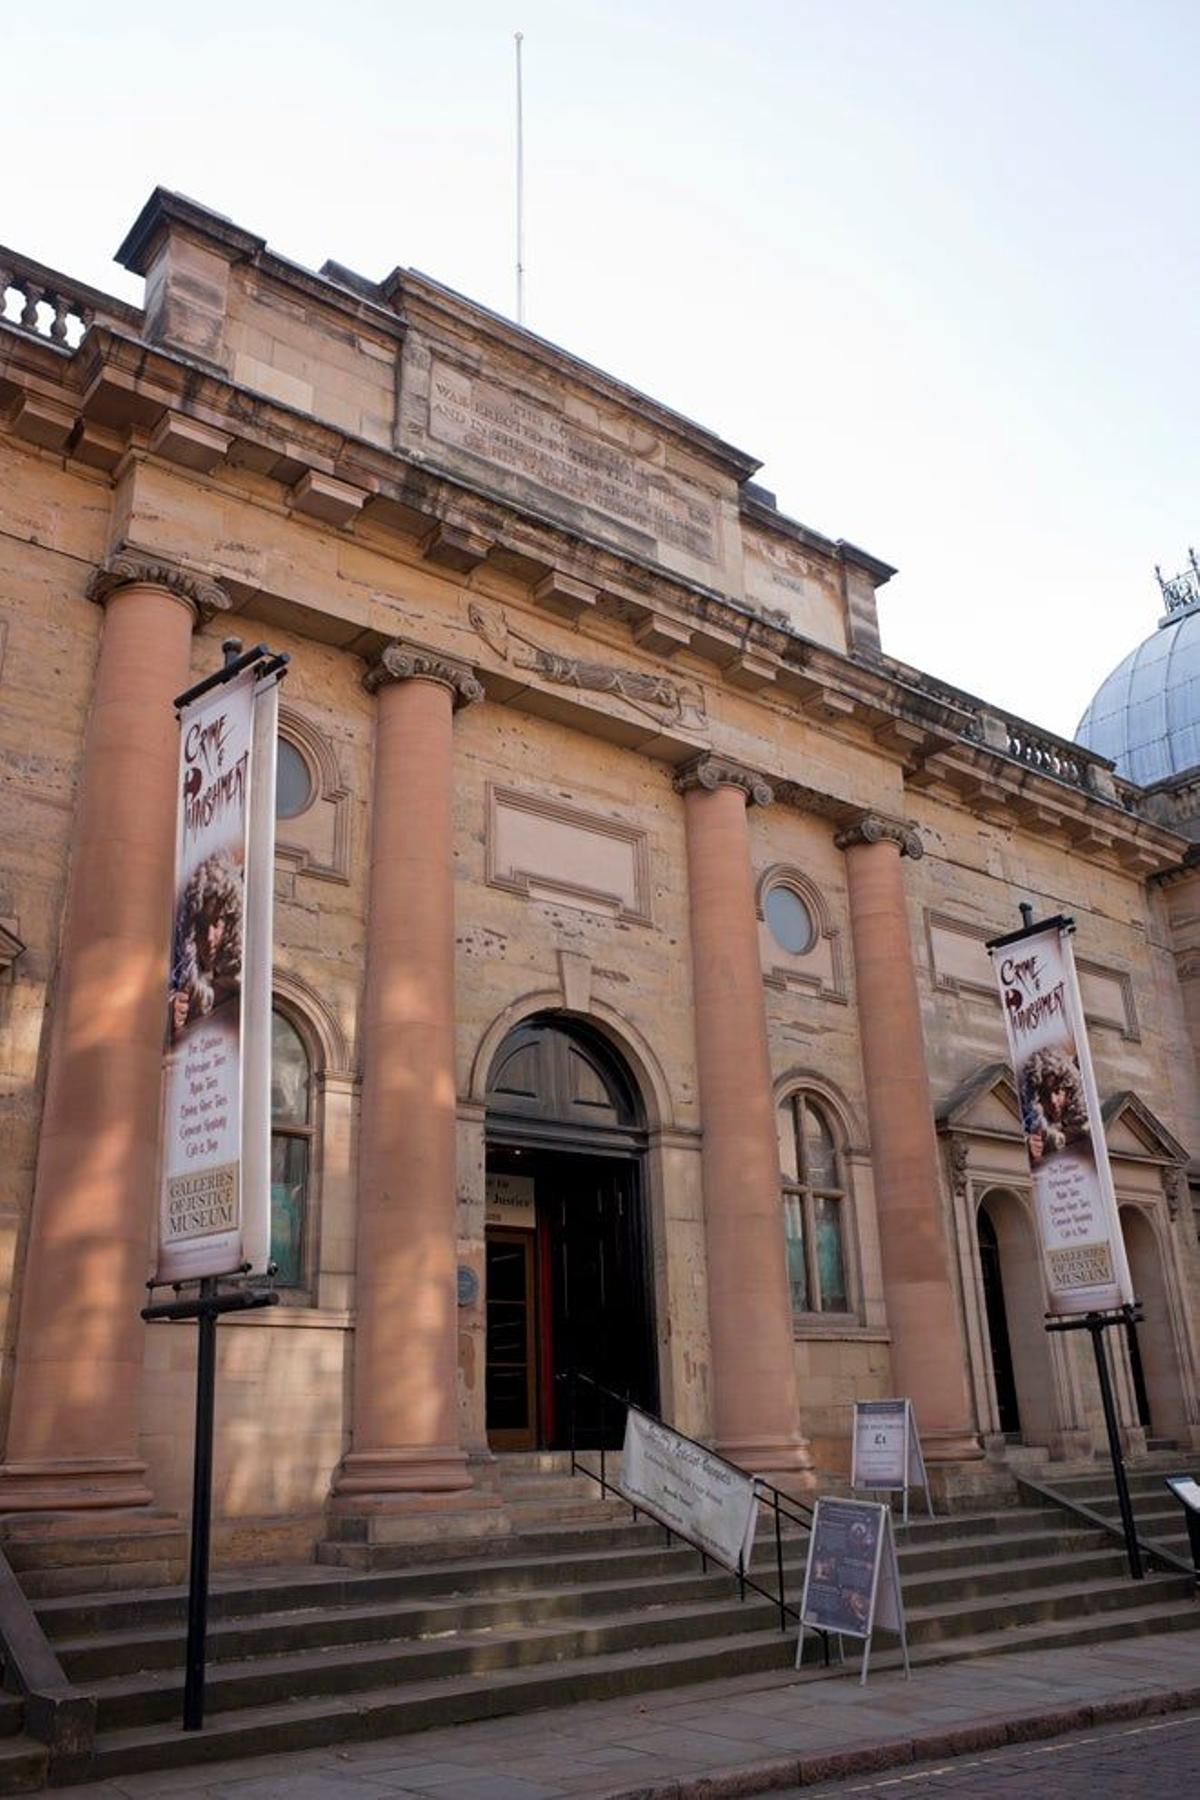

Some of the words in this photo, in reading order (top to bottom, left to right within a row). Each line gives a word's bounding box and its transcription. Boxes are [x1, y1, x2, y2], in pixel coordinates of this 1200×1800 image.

[433, 401, 466, 426] AND
[169, 1170, 234, 1198] GALLERIES
[170, 1198, 185, 1215] OF
[187, 1187, 234, 1212] JUSTICE
[169, 1204, 233, 1235] MUSEUM
[1055, 1267, 1110, 1287] MUSEUM
